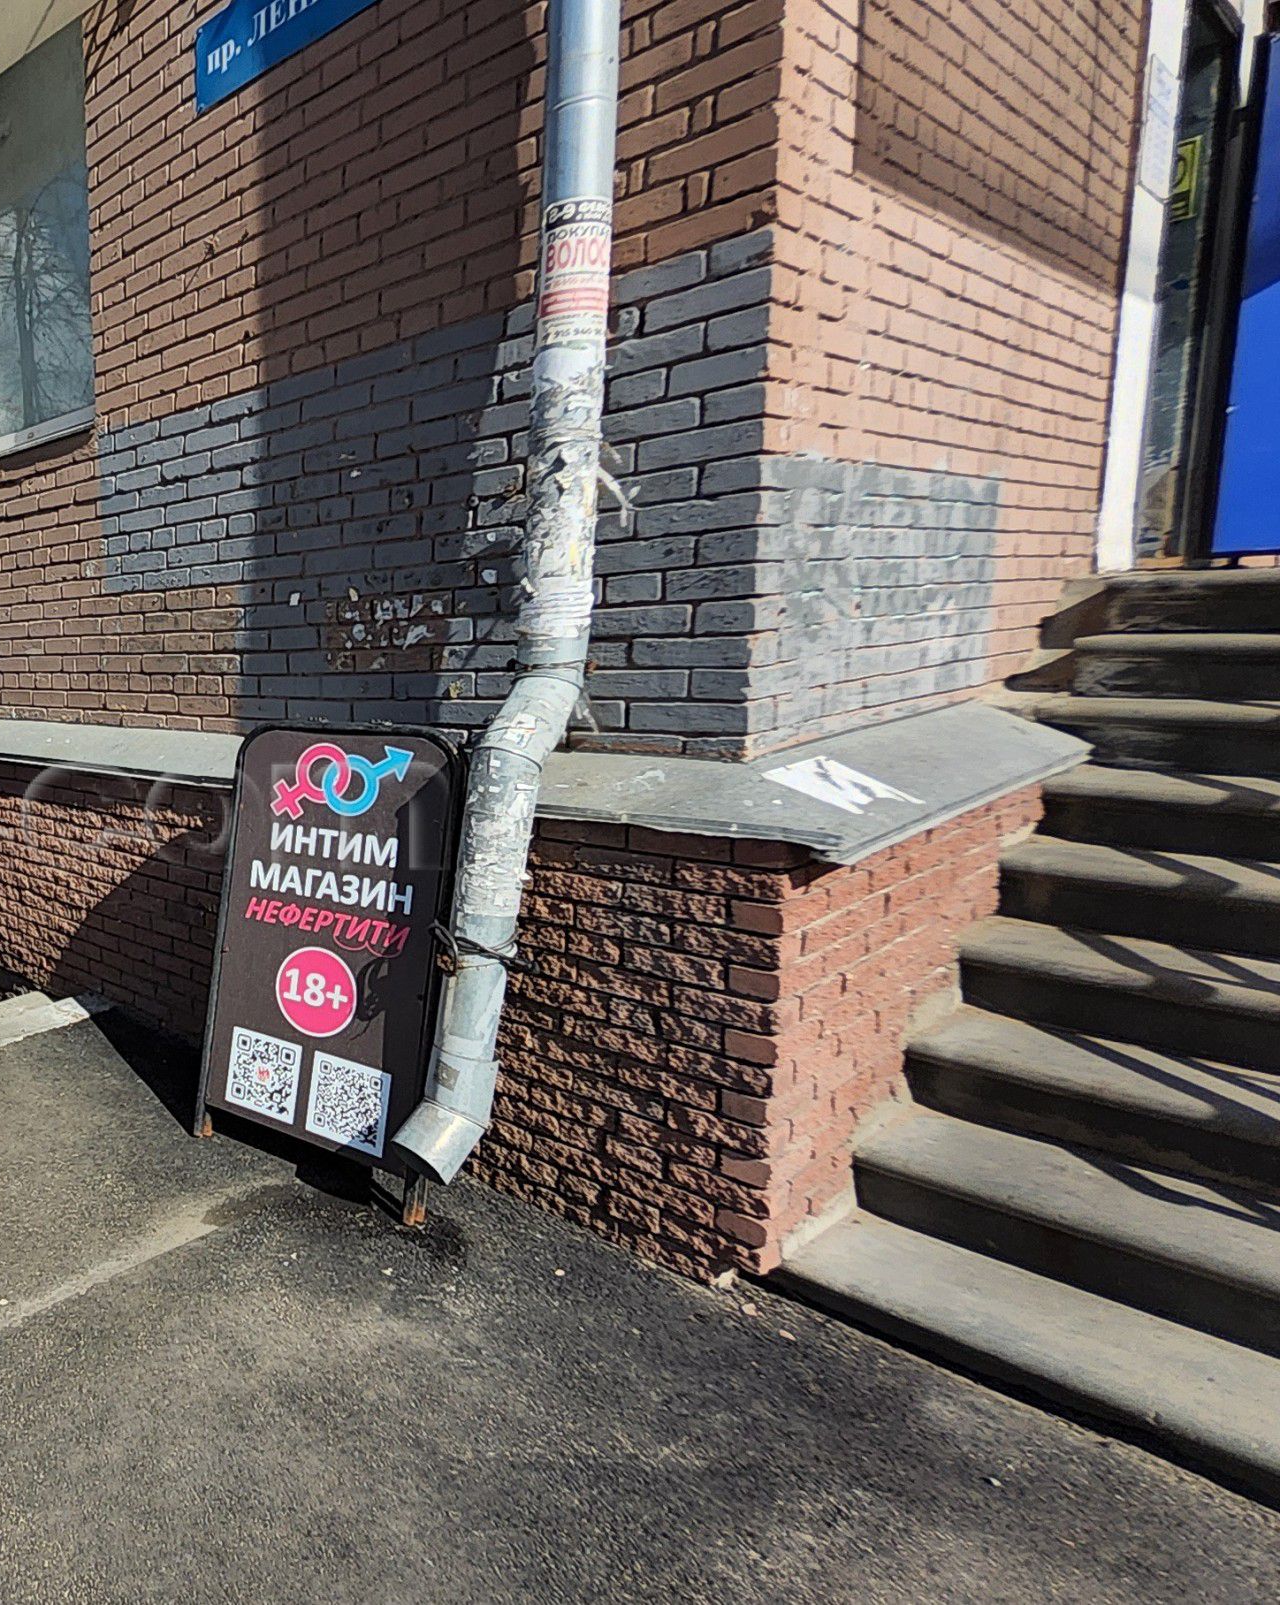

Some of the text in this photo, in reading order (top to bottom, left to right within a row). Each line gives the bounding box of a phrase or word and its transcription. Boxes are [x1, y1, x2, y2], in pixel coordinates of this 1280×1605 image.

[207, 38, 242, 75] пр.
[269, 822, 399, 869] ИНТИМ
[249, 859, 414, 915] МАГАЗИН
[245, 896, 411, 957] НЕФЕРТИТИ
[283, 967, 349, 1013] 18+
